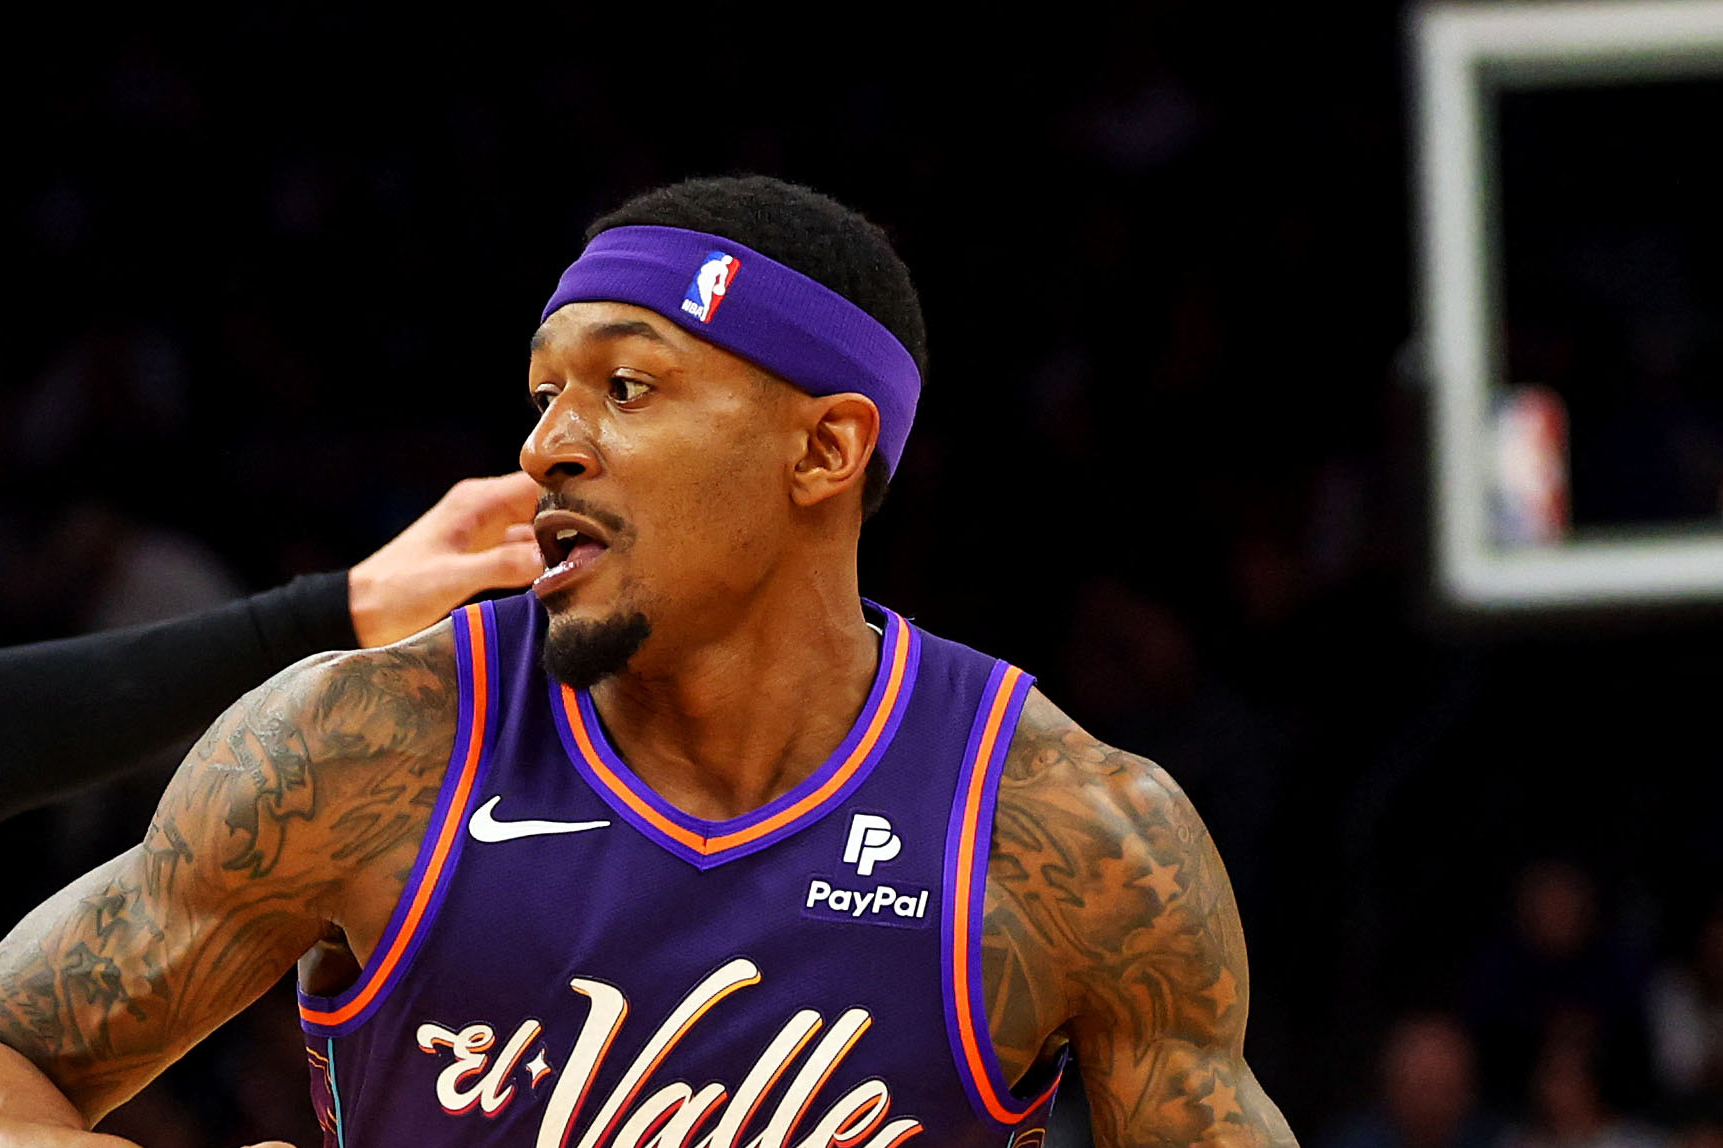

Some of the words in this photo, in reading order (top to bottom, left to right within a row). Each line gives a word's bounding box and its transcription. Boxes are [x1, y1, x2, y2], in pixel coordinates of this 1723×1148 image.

[681, 298, 704, 318] NBA
[806, 880, 929, 918] PayPal
[416, 1018, 543, 1118] El
